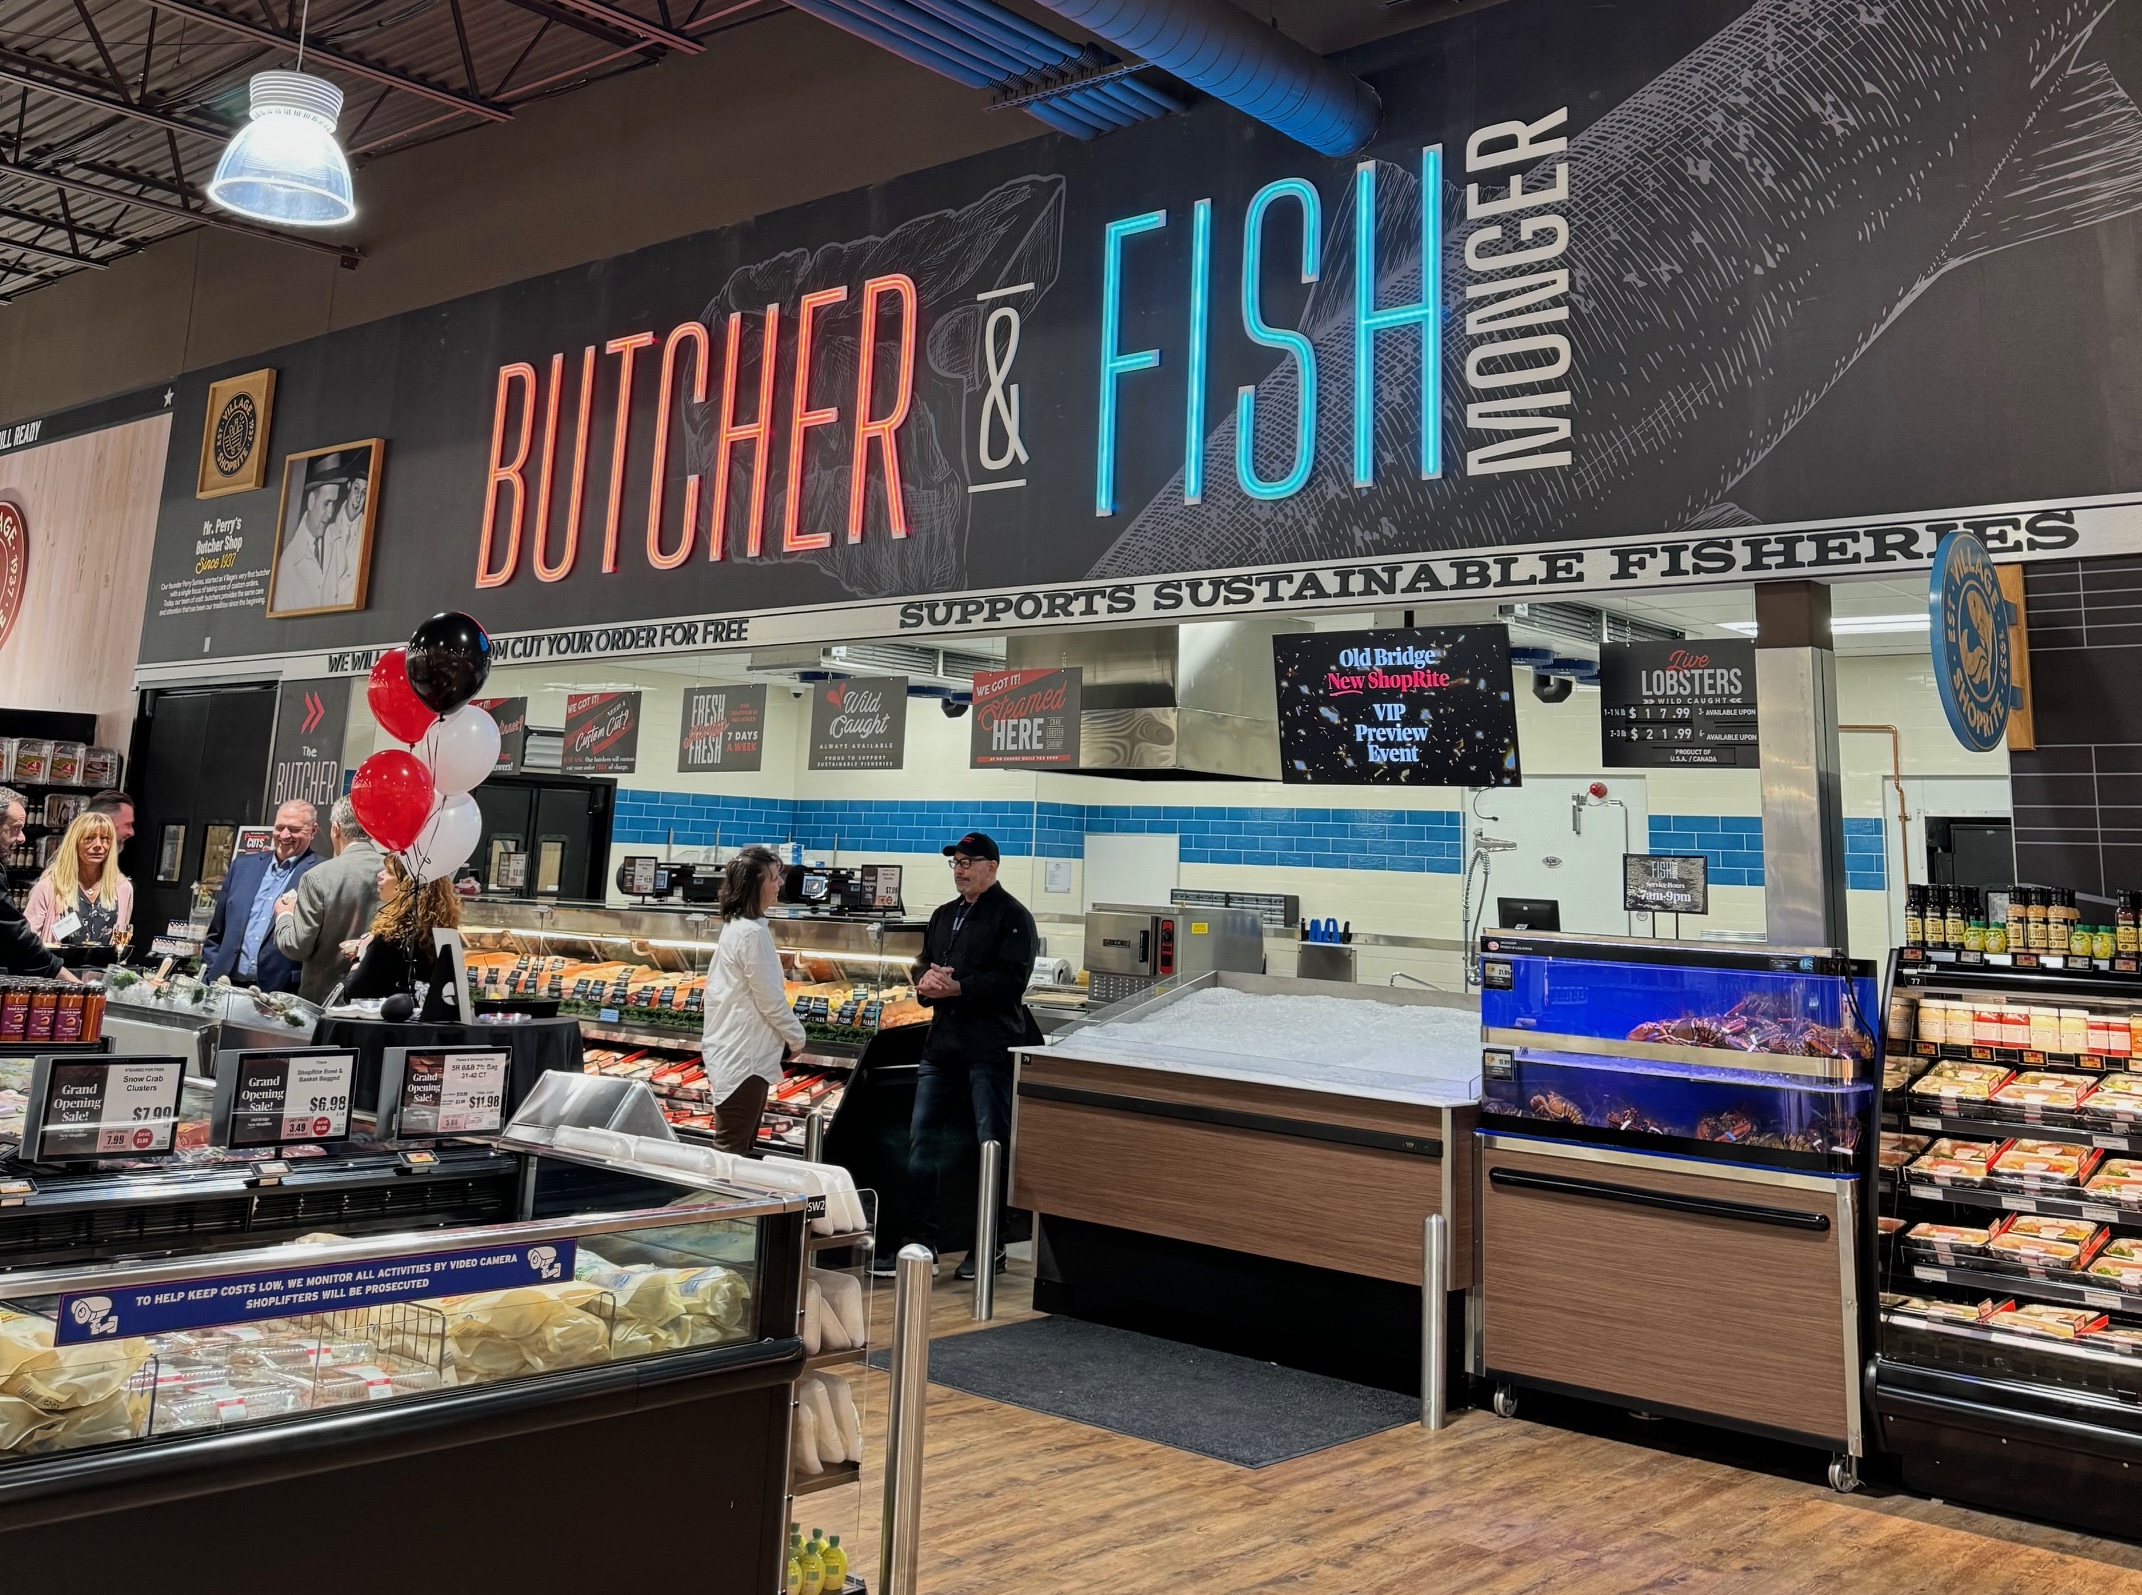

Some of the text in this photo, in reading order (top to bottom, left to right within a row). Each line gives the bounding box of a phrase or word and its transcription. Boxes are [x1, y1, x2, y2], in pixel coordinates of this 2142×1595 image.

[1465, 106, 1573, 477] MONGER
[1095, 142, 1443, 518] FISH
[223, 397, 253, 420] VILLAGE
[0, 420, 42, 450] ILL READY
[475, 272, 1031, 590] BUTCHER &
[217, 448, 249, 473] SHOPRITE
[203, 517, 242, 536] Mr. Perry's
[195, 535, 243, 555] Butcher Shop
[195, 552, 237, 575] Since 1937
[899, 509, 2081, 629] SUPPORTS SUSTAINABLE FISHERIES
[1950, 546, 2000, 612] VILLAGE
[511, 636, 543, 659] CUT
[546, 632, 594, 657] YOUR
[595, 626, 657, 651] ORDER
[659, 622, 698, 647] FOR
[702, 619, 749, 643] FREE
[328, 653, 350, 673] WE
[1339, 645, 1436, 669] Old Bridge
[1666, 649, 1710, 675] Live
[1999, 632, 2007, 687] 1937
[976, 672, 1021, 697] WE GOT IT!
[1327, 669, 1450, 692] New ShopRite
[1641, 668, 1743, 696] LOBSTERS
[567, 693, 600, 714] WE GOT IT!
[607, 704, 622, 717] NEED
[691, 693, 726, 728] FRESH
[842, 690, 882, 714] Wild
[977, 679, 1068, 732] Steamed
[1952, 667, 2005, 738] SHOPRITE
[1372, 703, 1406, 722] VIP
[575, 709, 629, 753] Custom Cut?
[829, 712, 890, 739] Caught
[992, 717, 1044, 751] HERE
[1354, 723, 1429, 743] Preview
[727, 731, 758, 741] 7 DAYS
[1706, 733, 1739, 741] AVAILABLE
[302, 746, 318, 757] The
[688, 732, 723, 764] FRESH
[726, 742, 757, 752] A WEEK
[1366, 743, 1420, 763] Event
[274, 761, 338, 806] BUTCHER
[246, 838, 264, 848] CUTS
[1651, 861, 1672, 879] FISH
[1910, 977, 1921, 985] 77
[123, 1075, 164, 1083] Snow Crab
[248, 1075, 280, 1087] Grand
[412, 1072, 438, 1082] Grand
[61, 1083, 98, 1095] Grand
[126, 1084, 157, 1092] Clusters
[241, 1089, 285, 1102] Opening
[407, 1083, 441, 1094] Opening
[413, 1093, 433, 1103] Sale!
[53, 1097, 102, 1111] Opening
[249, 1101, 274, 1112] Sale!
[309, 1095, 347, 1113] $6.98
[469, 1095, 500, 1109] $11.98
[61, 1111, 89, 1122] Sale!
[289, 1123, 306, 1133] 3.49
[107, 1134, 125, 1145] 7.99
[807, 1200, 825, 1214] SW2
[136, 1253, 518, 1307] TO HELP KEEP COSTS LOW, WE MONITOR ALL ACTIVITIES BY VIDEO CAMERA
[245, 1278, 430, 1310] SHOPLIFTERS WILL BE PROSECUTED
